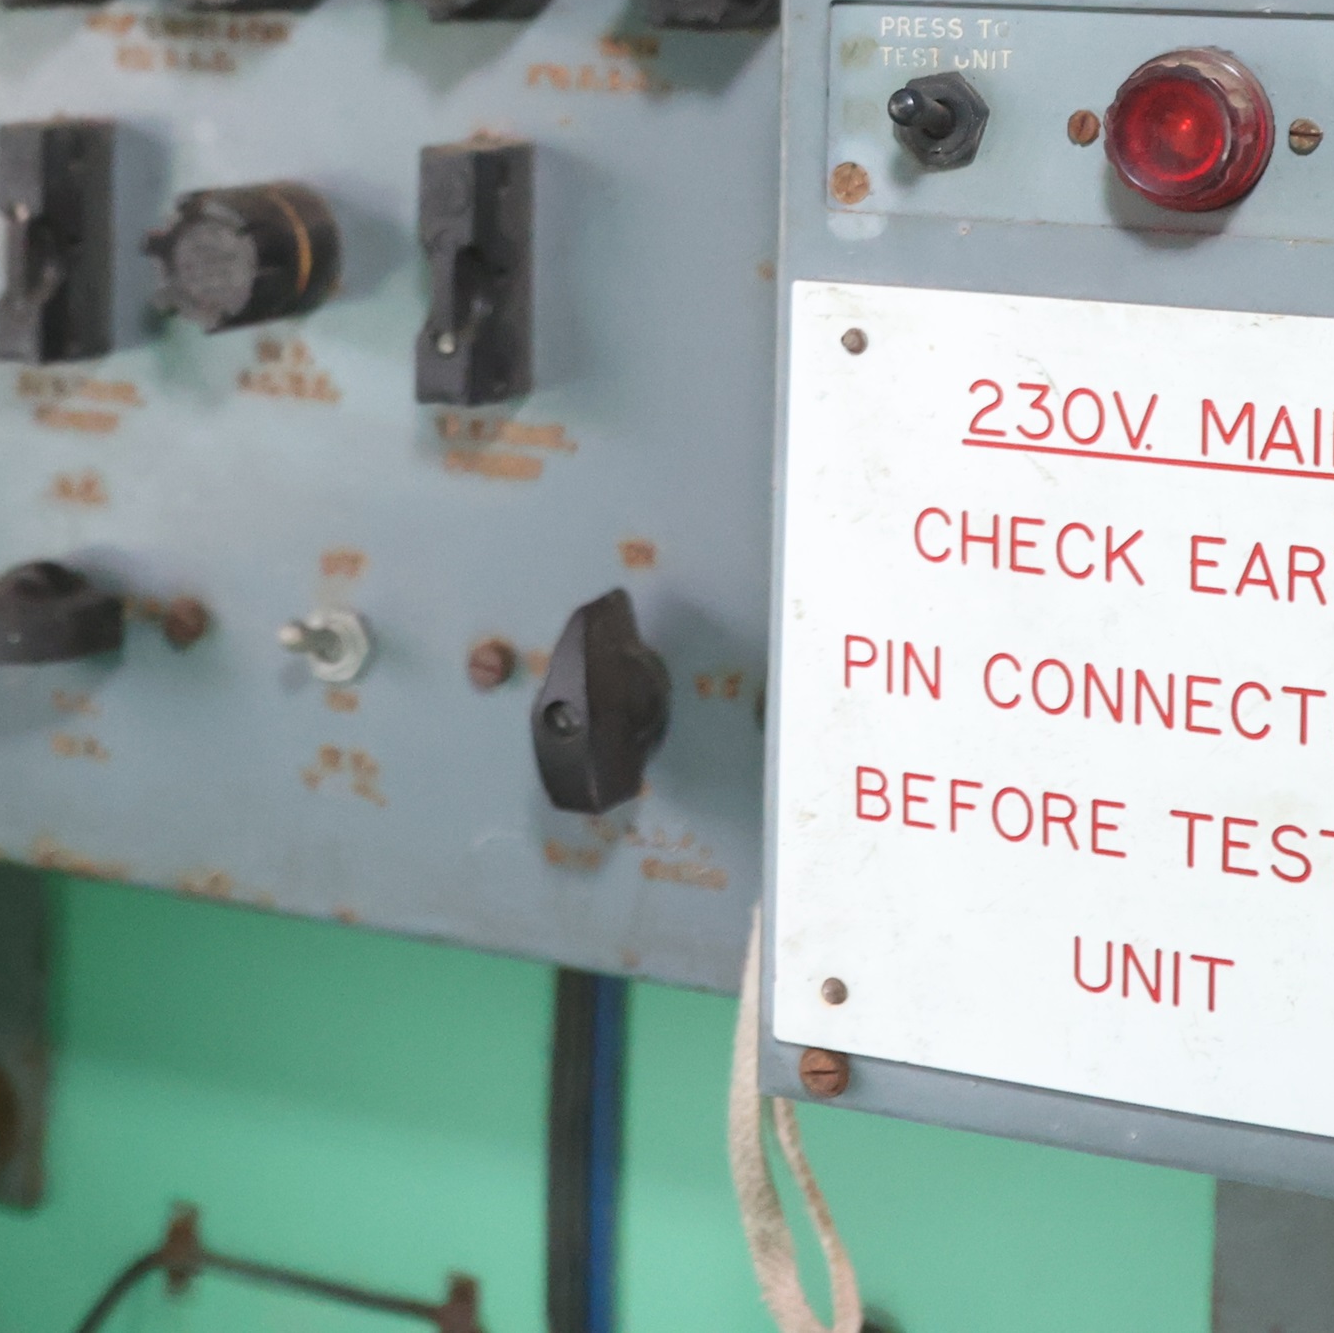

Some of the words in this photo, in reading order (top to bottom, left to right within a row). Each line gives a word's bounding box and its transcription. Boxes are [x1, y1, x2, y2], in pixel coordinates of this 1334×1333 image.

[879, 46, 941, 69] TEST
[954, 47, 1013, 70] UNIT
[880, 15, 964, 40] PRESS
[968, 378, 1159, 452] 230V.
[913, 506, 1145, 586] CHECK
[844, 634, 942, 701] PIN
[855, 765, 1128, 859] BEFORE
[1073, 936, 1236, 1013] UNIT
